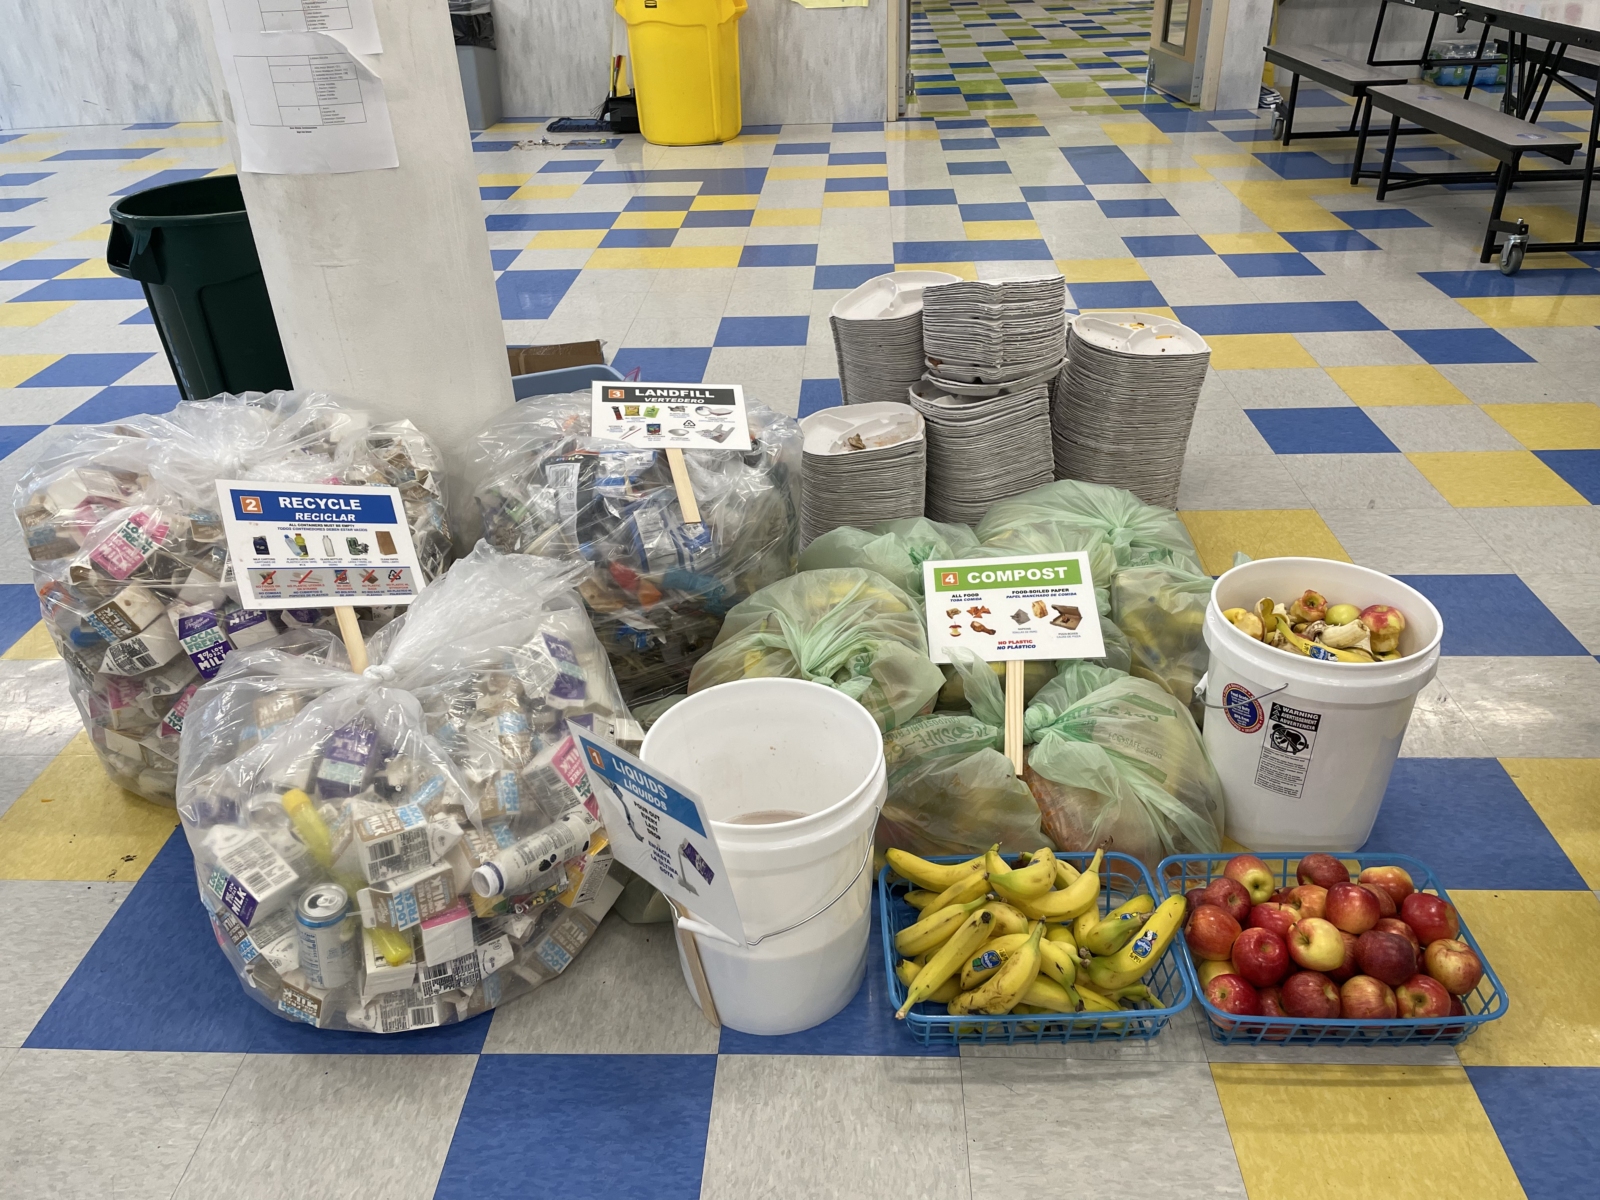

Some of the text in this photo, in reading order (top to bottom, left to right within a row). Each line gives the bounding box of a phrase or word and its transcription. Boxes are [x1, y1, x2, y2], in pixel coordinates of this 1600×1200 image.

[612, 389, 715, 398] 3 LANDFILL
[246, 496, 362, 511] 2 RECYCLE
[295, 512, 356, 522] RECICLAR
[945, 567, 1068, 584] 4 COMPOST
[183, 629, 219, 646] LOCAL
[187, 634, 224, 653] FRESH
[197, 645, 223, 661] 1% LOW
[1282, 706, 1319, 720] WARNING
[1280, 718, 1315, 730] ADVERTENCIA
[592, 751, 600, 765] 1
[612, 757, 668, 799] LIQUIDS
[623, 778, 667, 811] LÍQUIDOS
[634, 801, 660, 821] POUR OUT
[641, 811, 658, 826] EVERY
[366, 815, 387, 837] MILK
[645, 820, 658, 833] LAST
[231, 887, 247, 916] MILK
[430, 875, 447, 912] MILK
[394, 891, 408, 928] LOCAL
[561, 917, 588, 944] MILK
